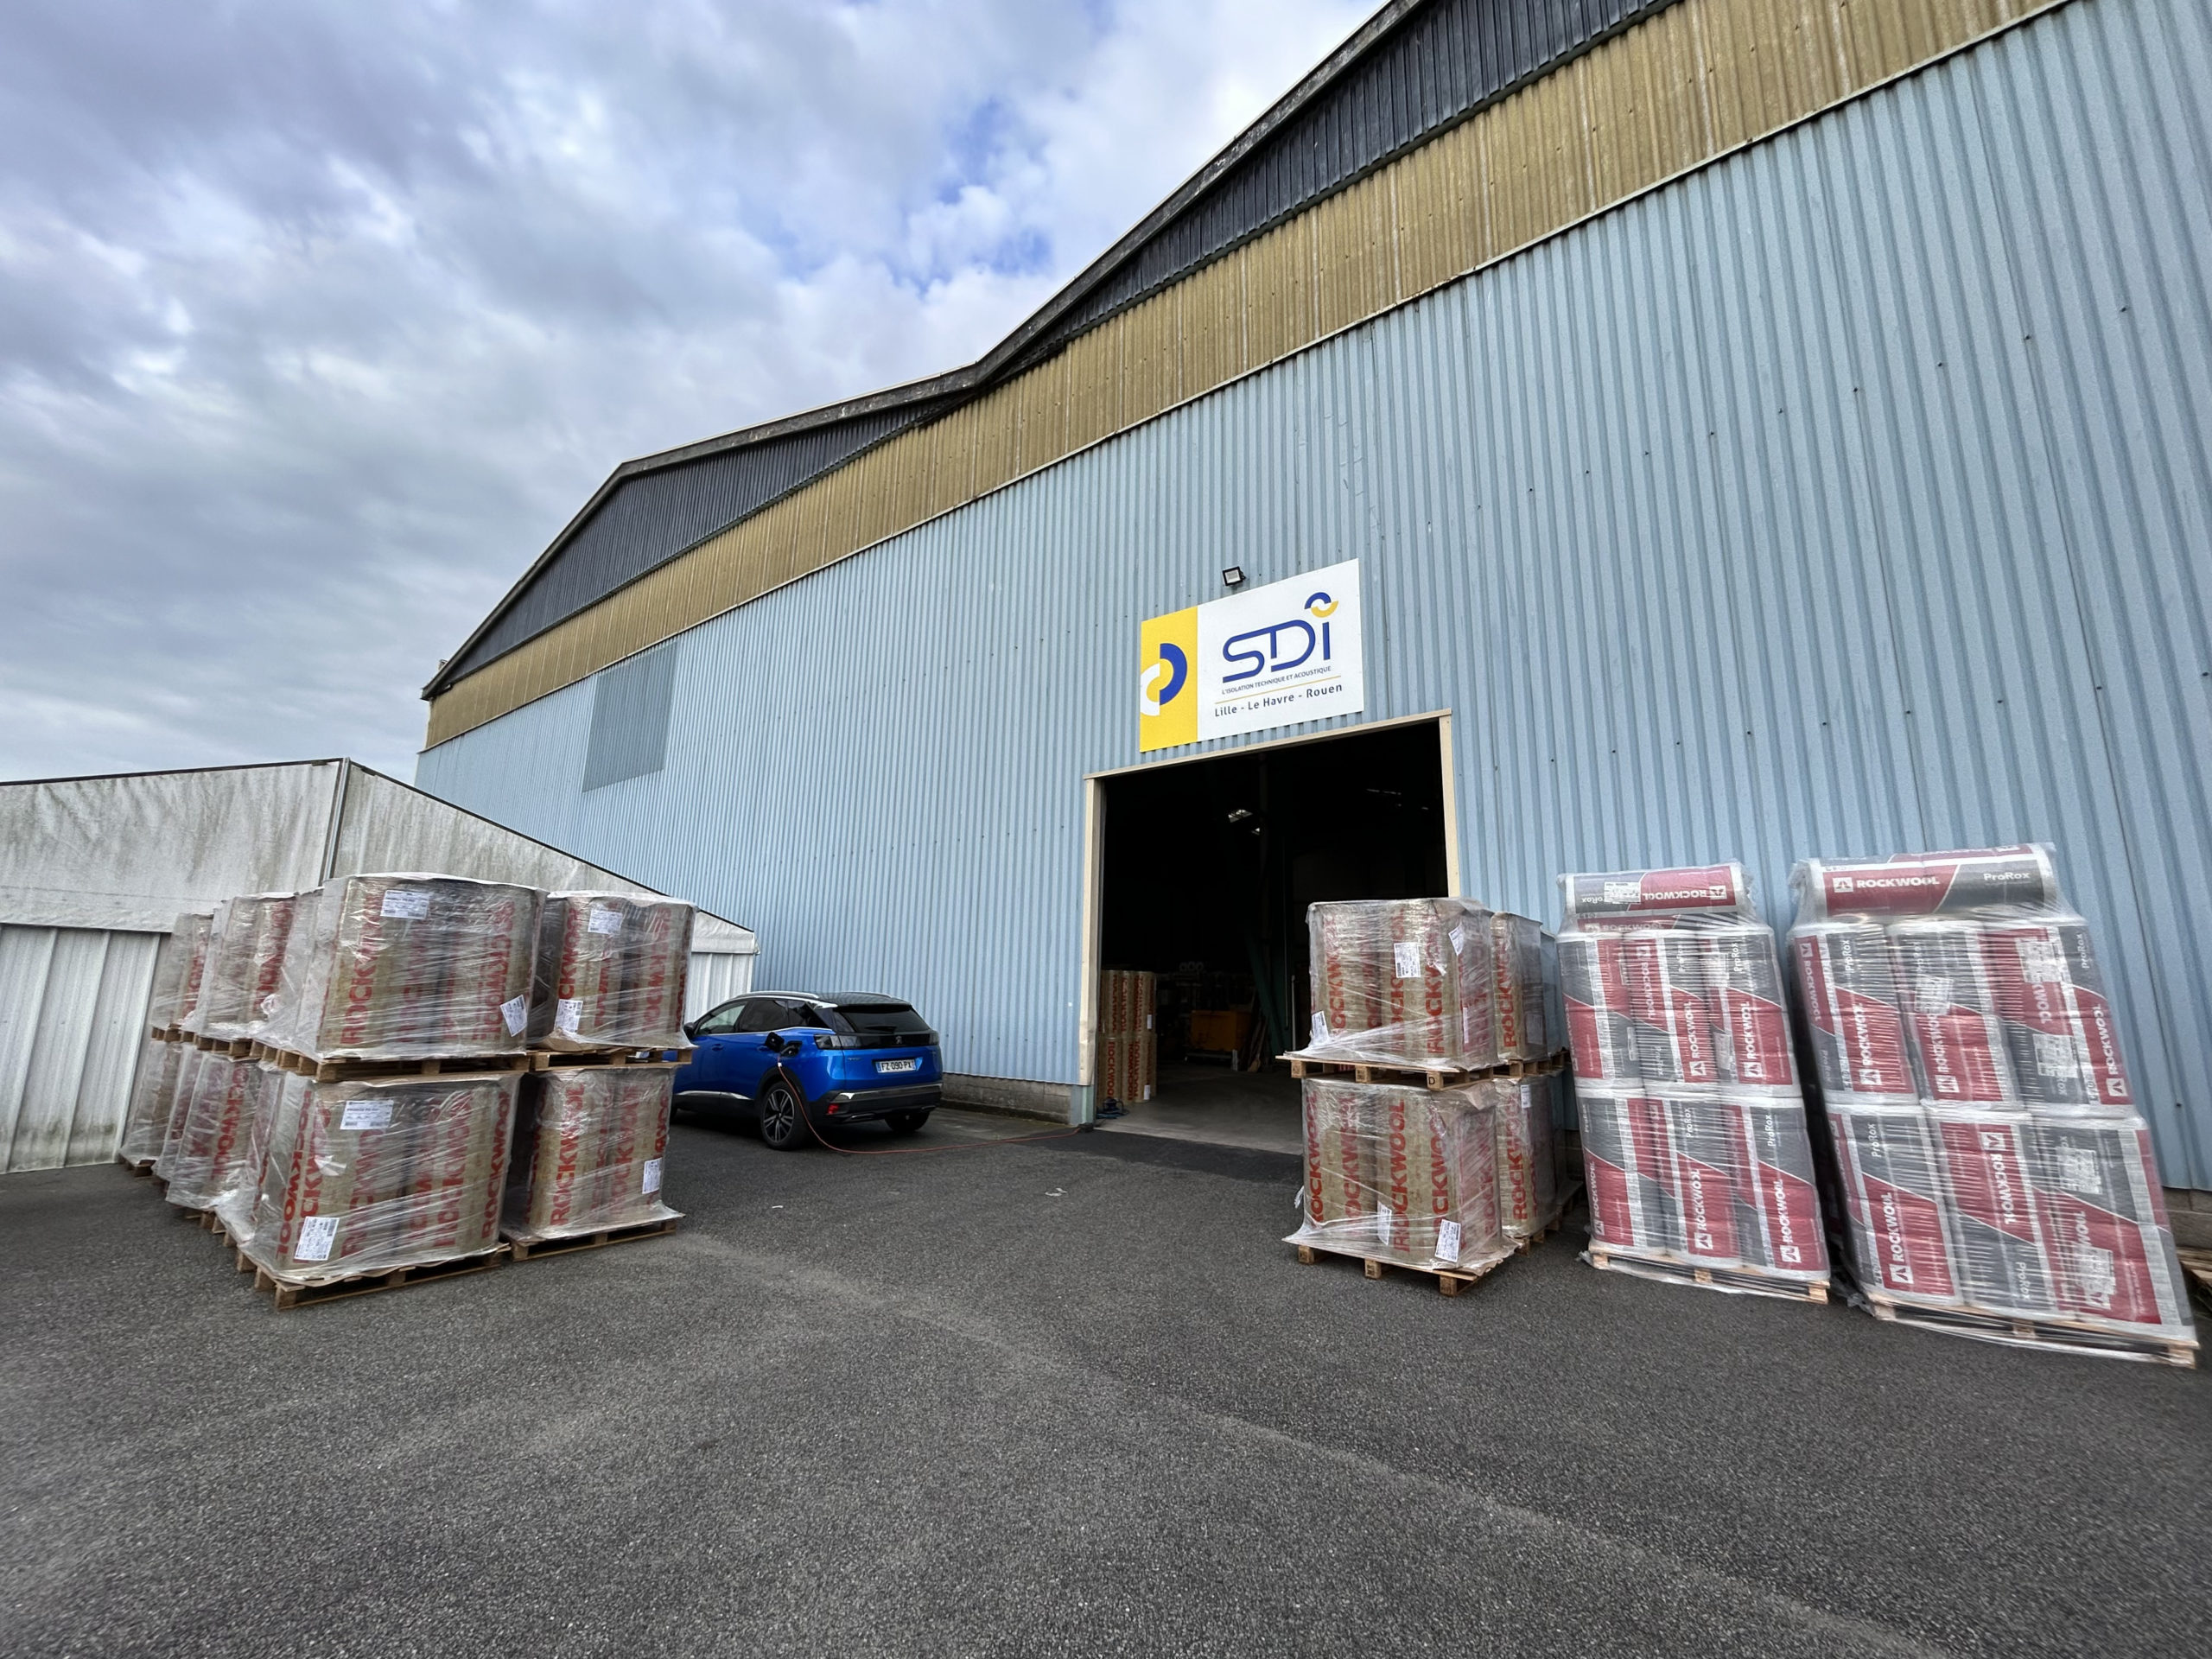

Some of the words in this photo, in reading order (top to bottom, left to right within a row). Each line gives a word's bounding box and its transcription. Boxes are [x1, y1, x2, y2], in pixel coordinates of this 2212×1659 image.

[1215, 705, 1237, 717] Lille
[1248, 701, 1260, 710] Le
[1263, 694, 1294, 708] Havre
[1306, 683, 1343, 698] Rouen
[1222, 683, 1254, 695] L'ISOLATION
[1255, 677, 1286, 689] TECHNIQUE
[1294, 666, 1332, 679] ACOUSTIQUE
[1643, 888, 1707, 900] ROCKWOOL
[1857, 876, 1940, 888] ROCKWOOL
[1983, 871, 2031, 880] ProRox
[1731, 943, 1742, 972] ProRox
[1841, 940, 1854, 971] ProRox
[2076, 933, 2089, 969] ProRox
[1496, 937, 1516, 1047] ROCKWO
[1804, 961, 1821, 1020] ROCKWOOL
[2031, 978, 2052, 1024] KWOOL
[1684, 1001, 1700, 1058] ROCKWOOL
[1739, 1001, 1757, 1059] ROCKWOOL
[1927, 1014, 1948, 1073] ROCKWOO
[2093, 1004, 2118, 1074] ROCKWOOL
[1107, 1041, 1116, 1098] ROCKWOO
[1428, 1077, 1435, 1085] D
[2056, 1077, 2069, 1096] Rox
[1683, 1107, 1694, 1139] ProRox
[1764, 1115, 1776, 1147] ProRox
[1868, 1123, 1881, 1158] ProRox
[550, 1083, 585, 1226] ROCKWOOL
[1389, 1099, 1410, 1252] ROCKWOOL
[1589, 1160, 1599, 1217] ROCKWOOL
[1691, 1169, 1707, 1230] ROCKWOOL
[1775, 1179, 1791, 1243] ROCKWOOL
[1990, 1154, 2017, 1224] ROCKWOOL
[1881, 1192, 1904, 1262] ROCKWOOL
[2075, 1211, 2092, 1247] WOOL
[2017, 1262, 2031, 1300] ProRox
